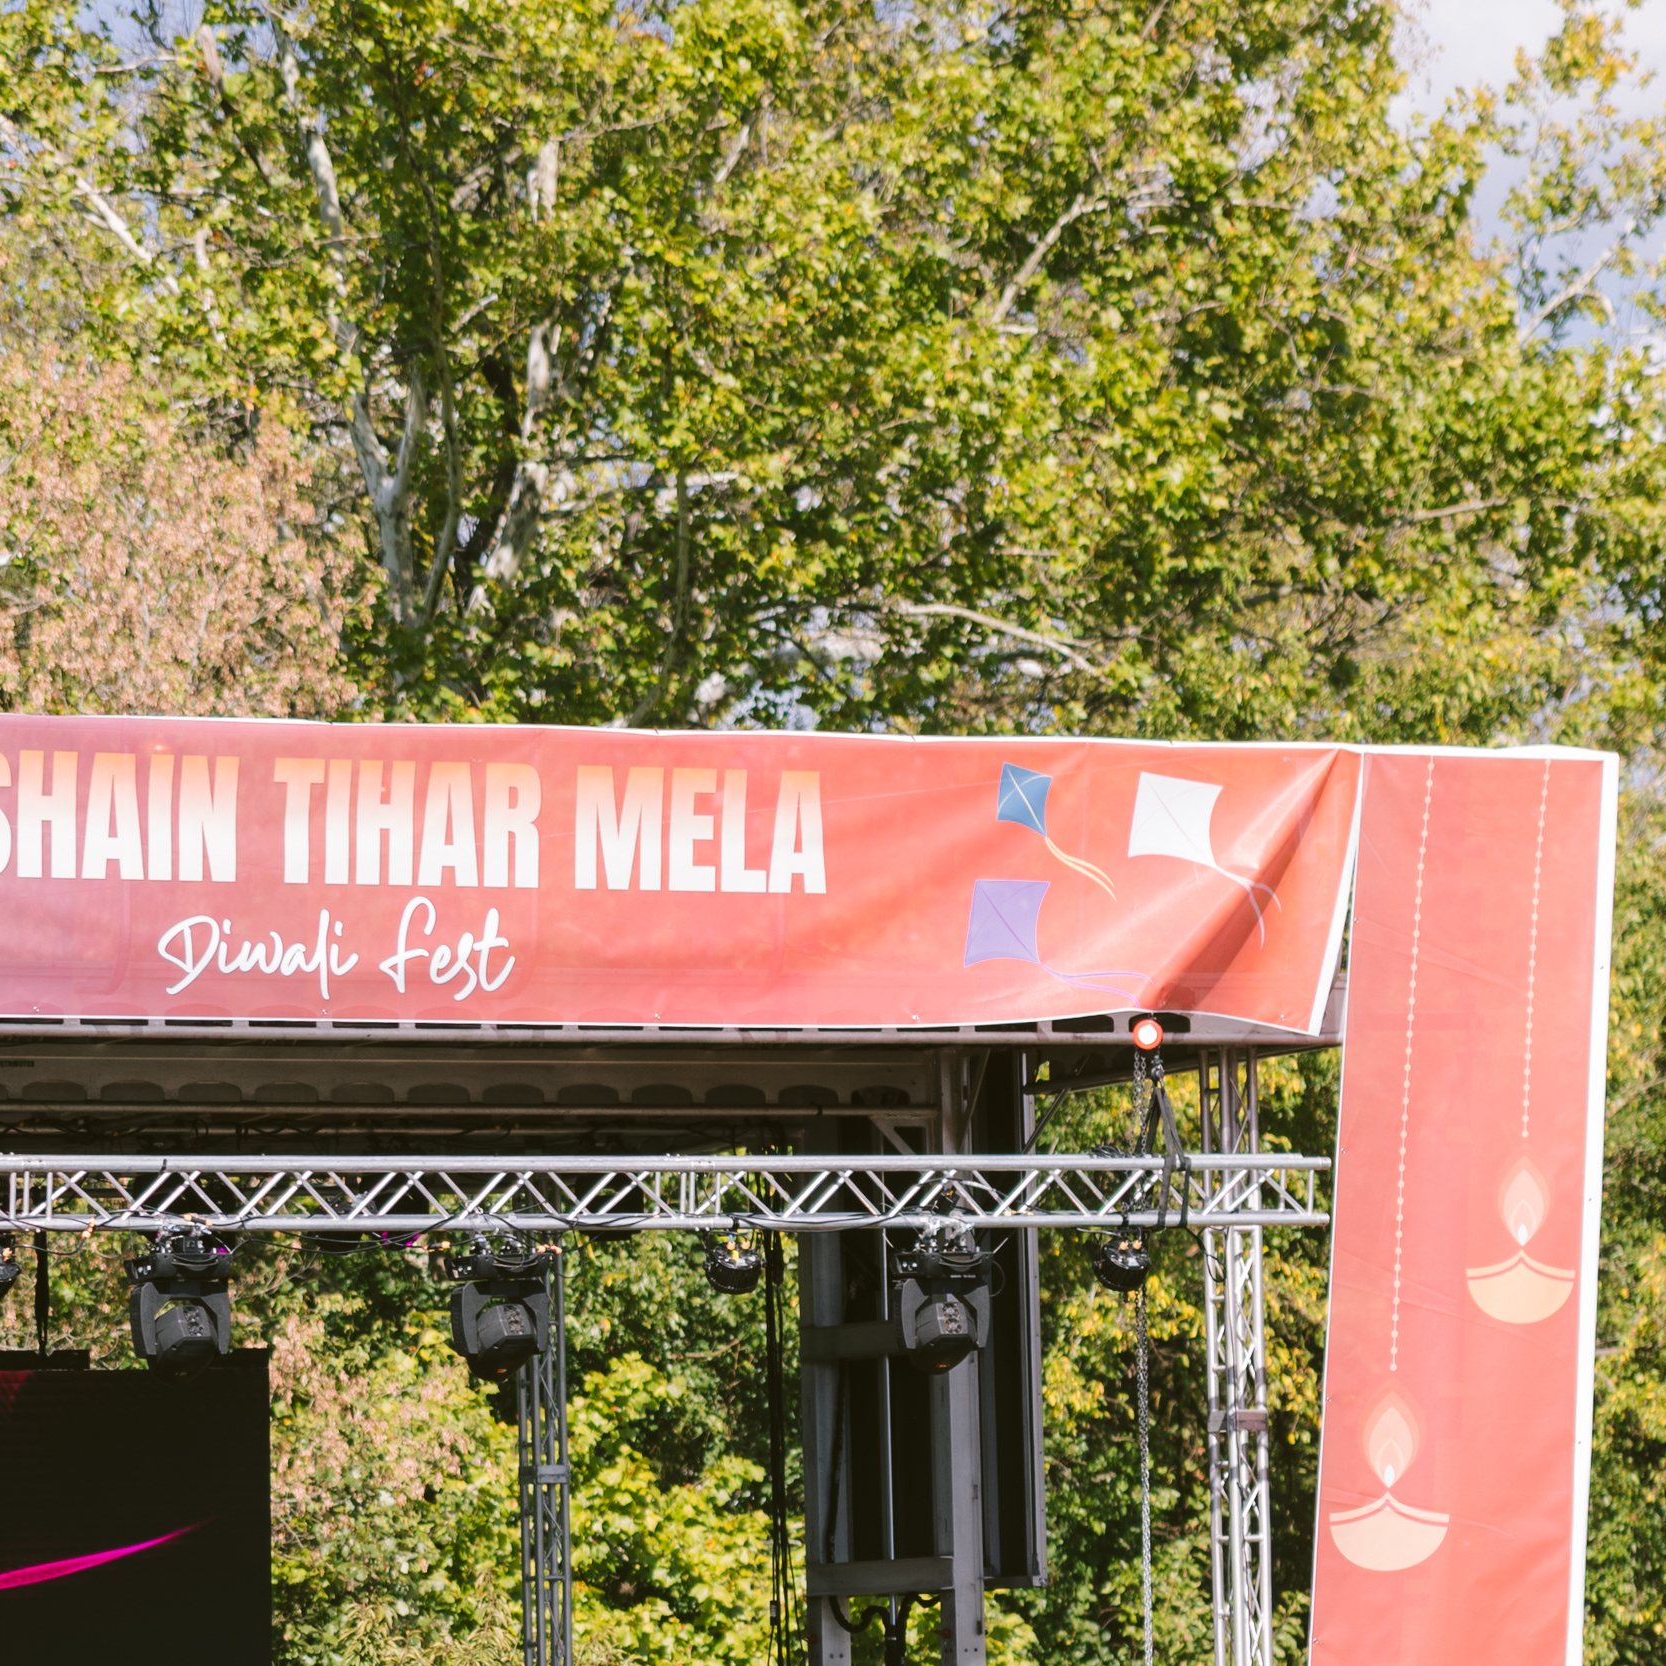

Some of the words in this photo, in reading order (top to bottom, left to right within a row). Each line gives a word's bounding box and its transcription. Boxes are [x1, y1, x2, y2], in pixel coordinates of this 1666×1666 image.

[273, 756, 543, 889] TIHAR
[574, 764, 827, 895] MELA
[157, 908, 360, 1001] Diwali
